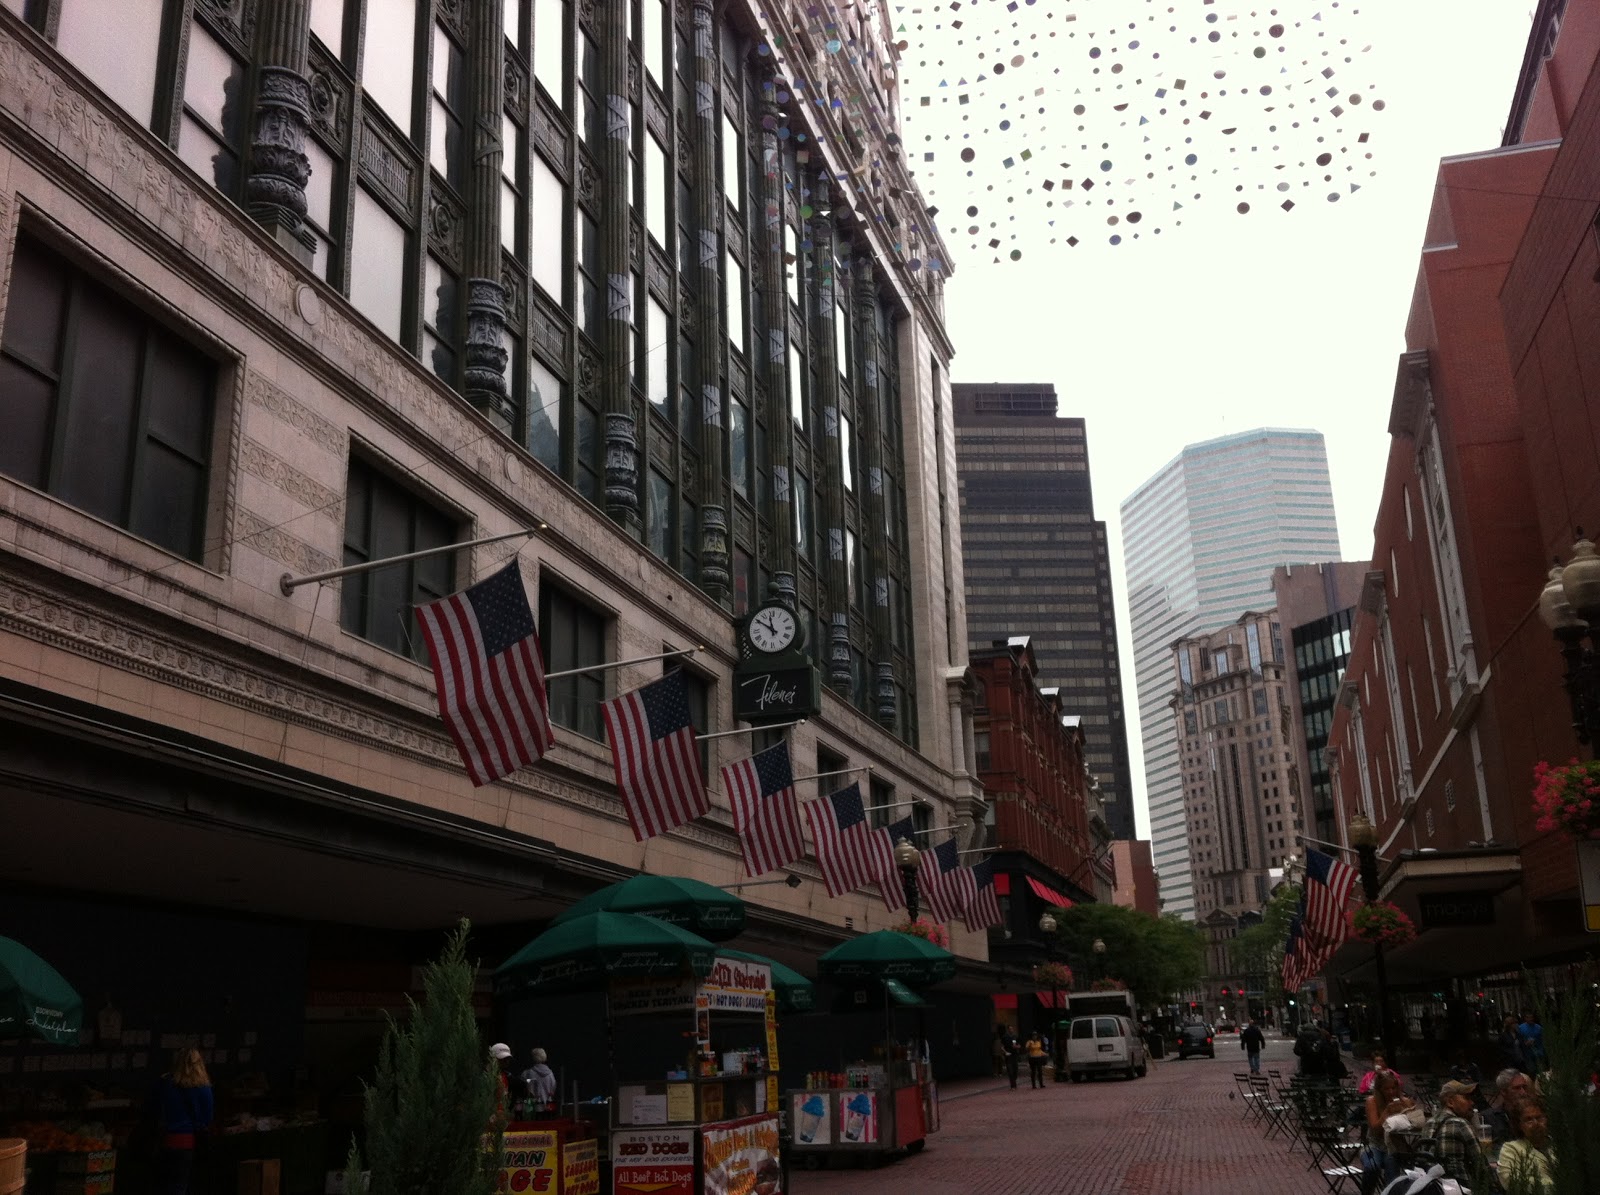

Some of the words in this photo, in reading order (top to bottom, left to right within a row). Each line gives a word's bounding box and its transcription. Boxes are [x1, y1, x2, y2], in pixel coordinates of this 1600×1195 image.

[745, 996, 766, 1010] SAUSAG
[629, 1134, 680, 1143] BOSTON
[619, 1143, 648, 1155] RED
[651, 1142, 689, 1155] DOGS
[618, 1171, 630, 1184] All
[654, 1168, 669, 1183] Hot
[672, 1170, 692, 1188] Dogs
